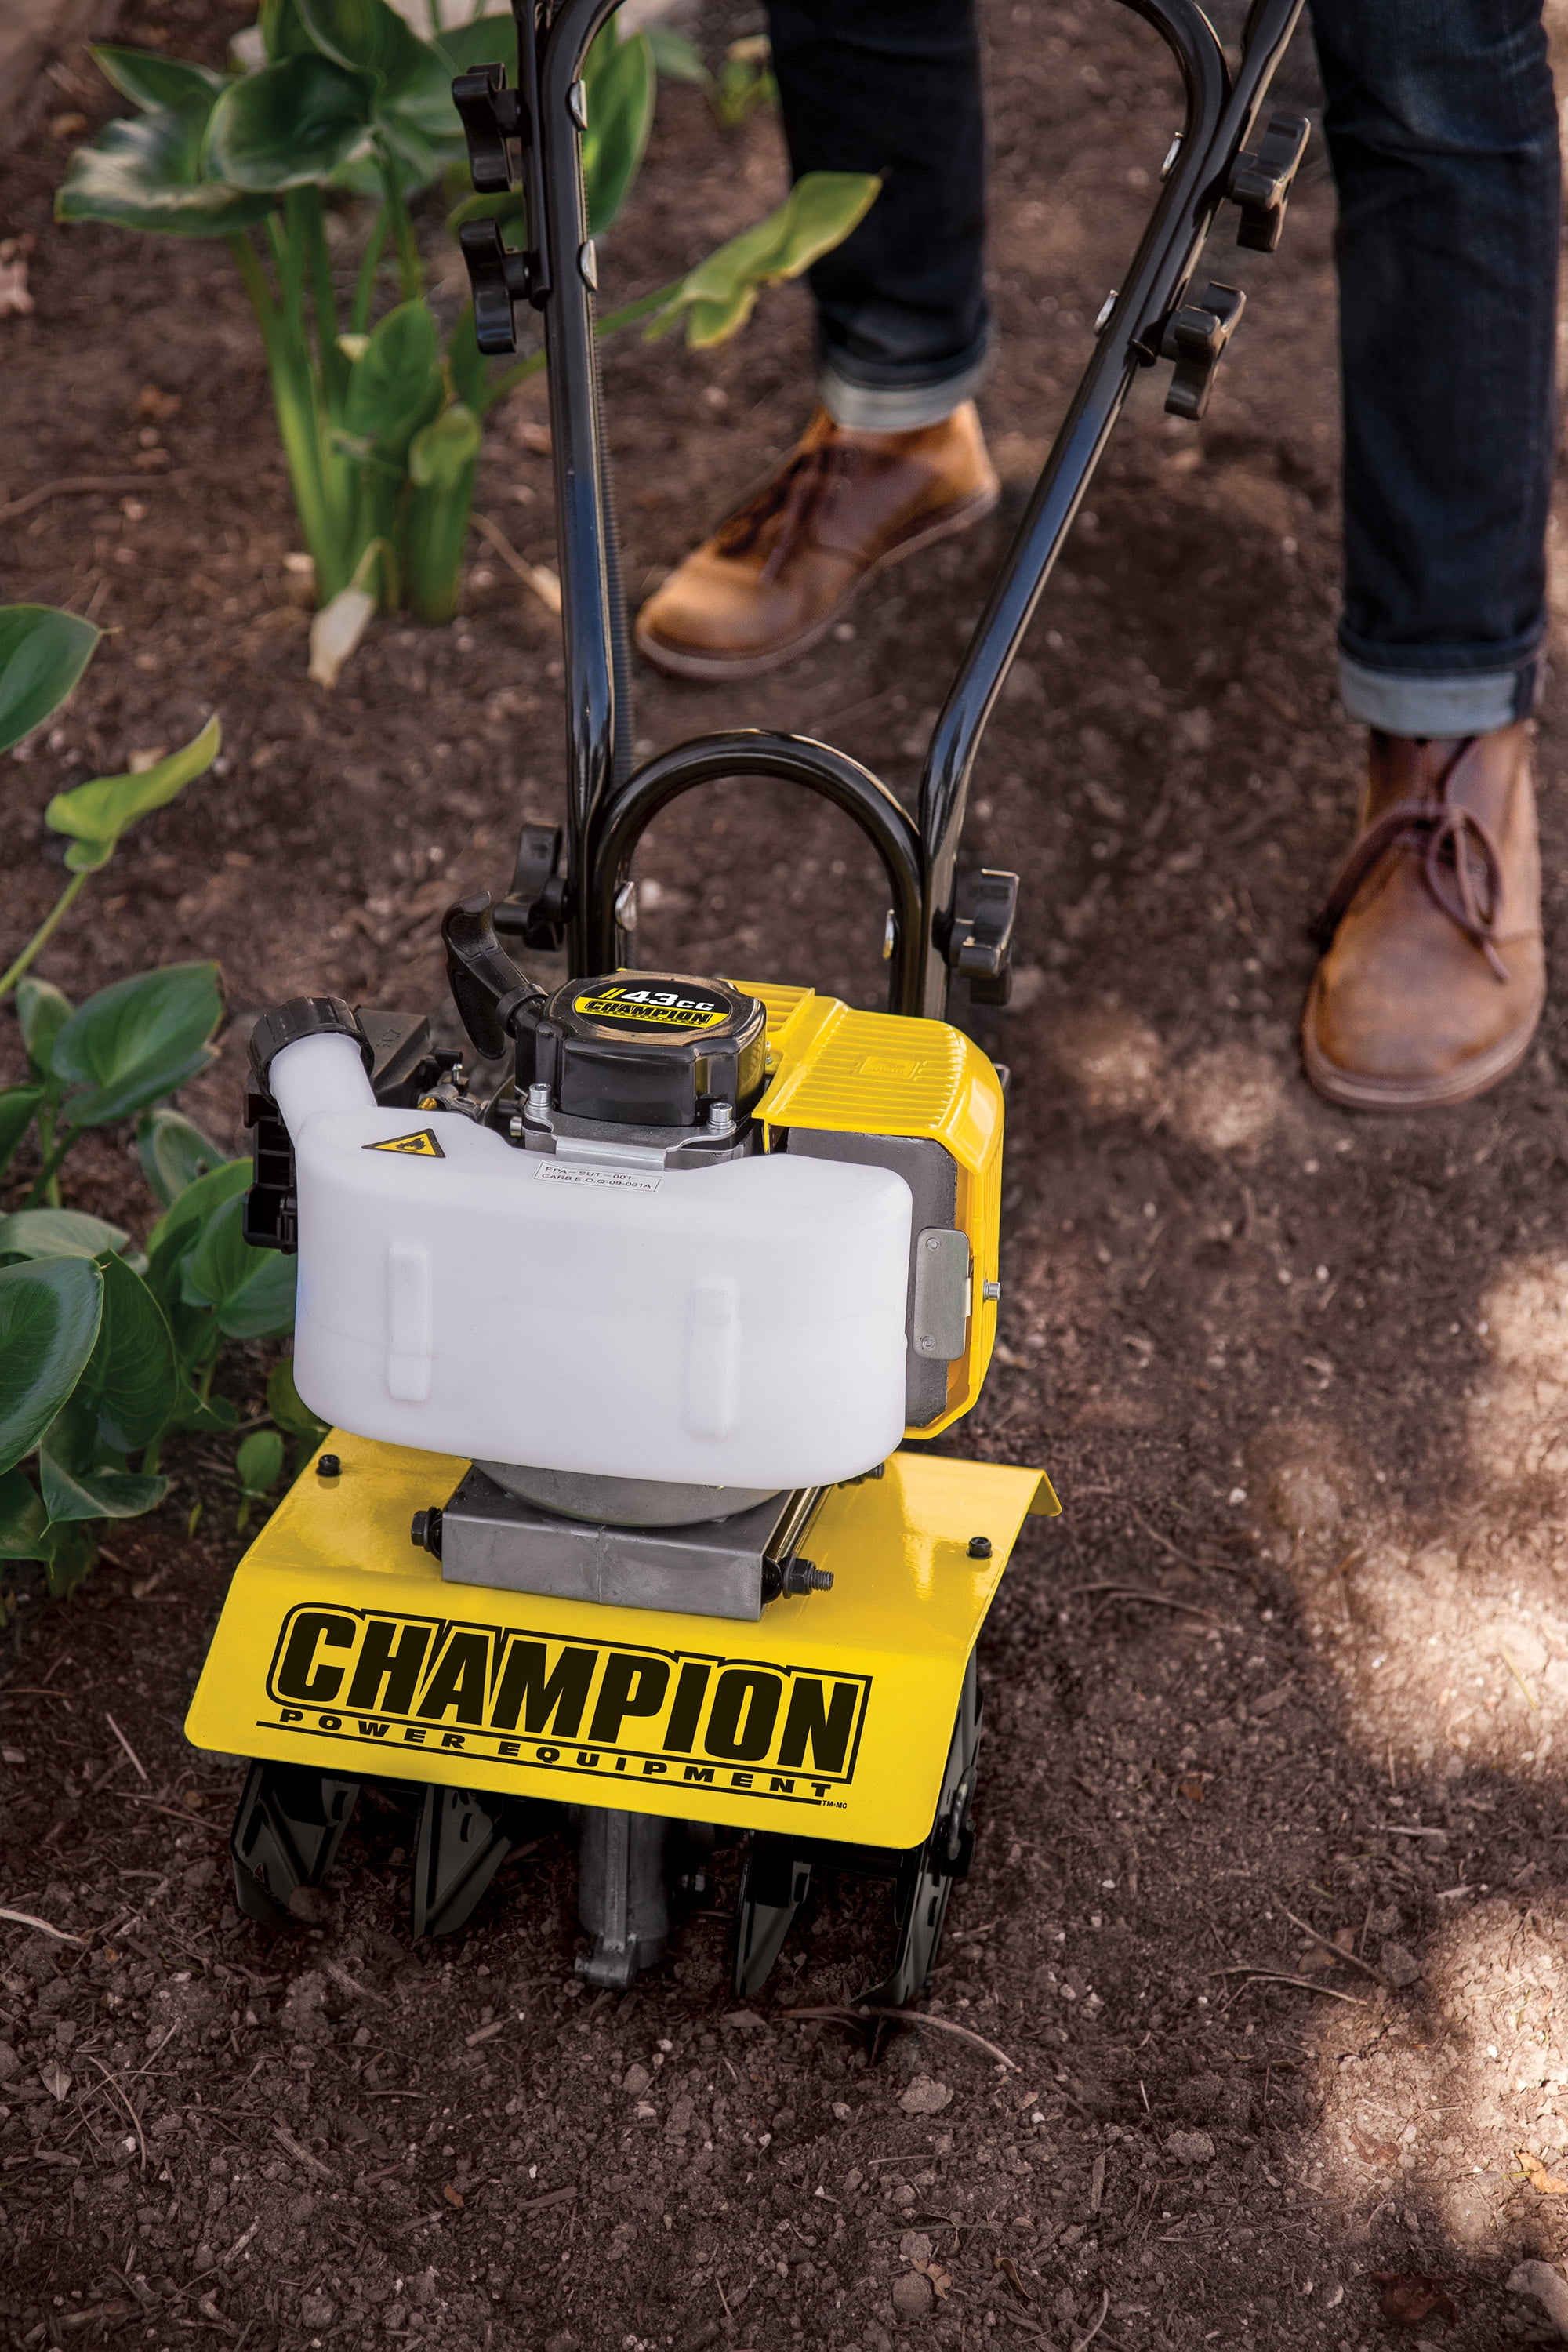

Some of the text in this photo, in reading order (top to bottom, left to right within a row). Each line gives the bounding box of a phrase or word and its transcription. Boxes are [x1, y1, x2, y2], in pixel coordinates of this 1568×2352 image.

[585, 1000, 712, 1024] CHAMPION
[621, 990, 715, 1011] 43cc
[541, 1173, 572, 1181] CARB
[277, 1611, 859, 1773] CHAMPION
[279, 1708, 832, 1798] POWER EQUIPMENT
